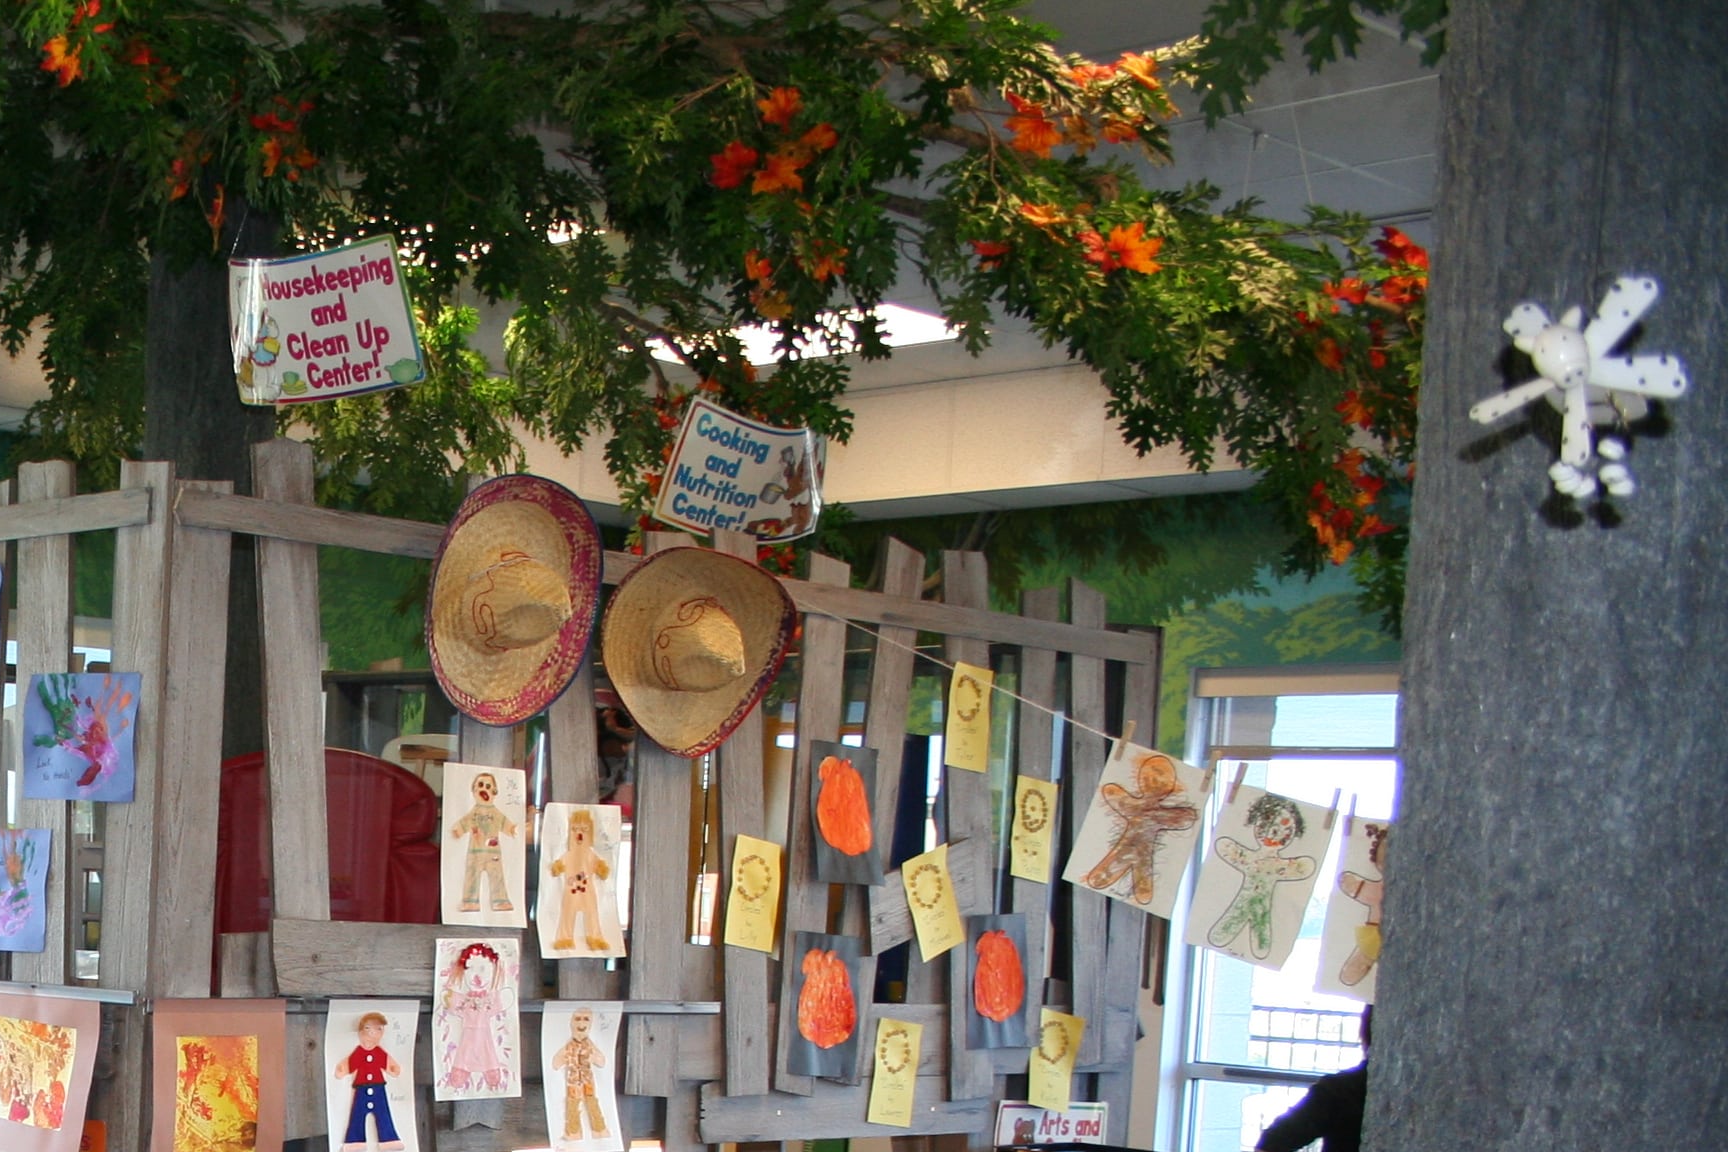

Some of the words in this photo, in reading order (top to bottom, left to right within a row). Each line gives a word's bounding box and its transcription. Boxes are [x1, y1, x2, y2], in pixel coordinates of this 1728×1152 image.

[262, 255, 394, 300] Housekeeping
[311, 293, 347, 326] and
[287, 332, 350, 360] Clean
[356, 319, 390, 352] Up
[307, 351, 382, 388] Center!
[697, 414, 770, 464] Cooking
[705, 455, 742, 478] and
[674, 464, 757, 509] Nutrition
[672, 493, 746, 531] Center!
[1039, 1110, 1070, 1136] Arts
[1075, 1112, 1101, 1137] and
